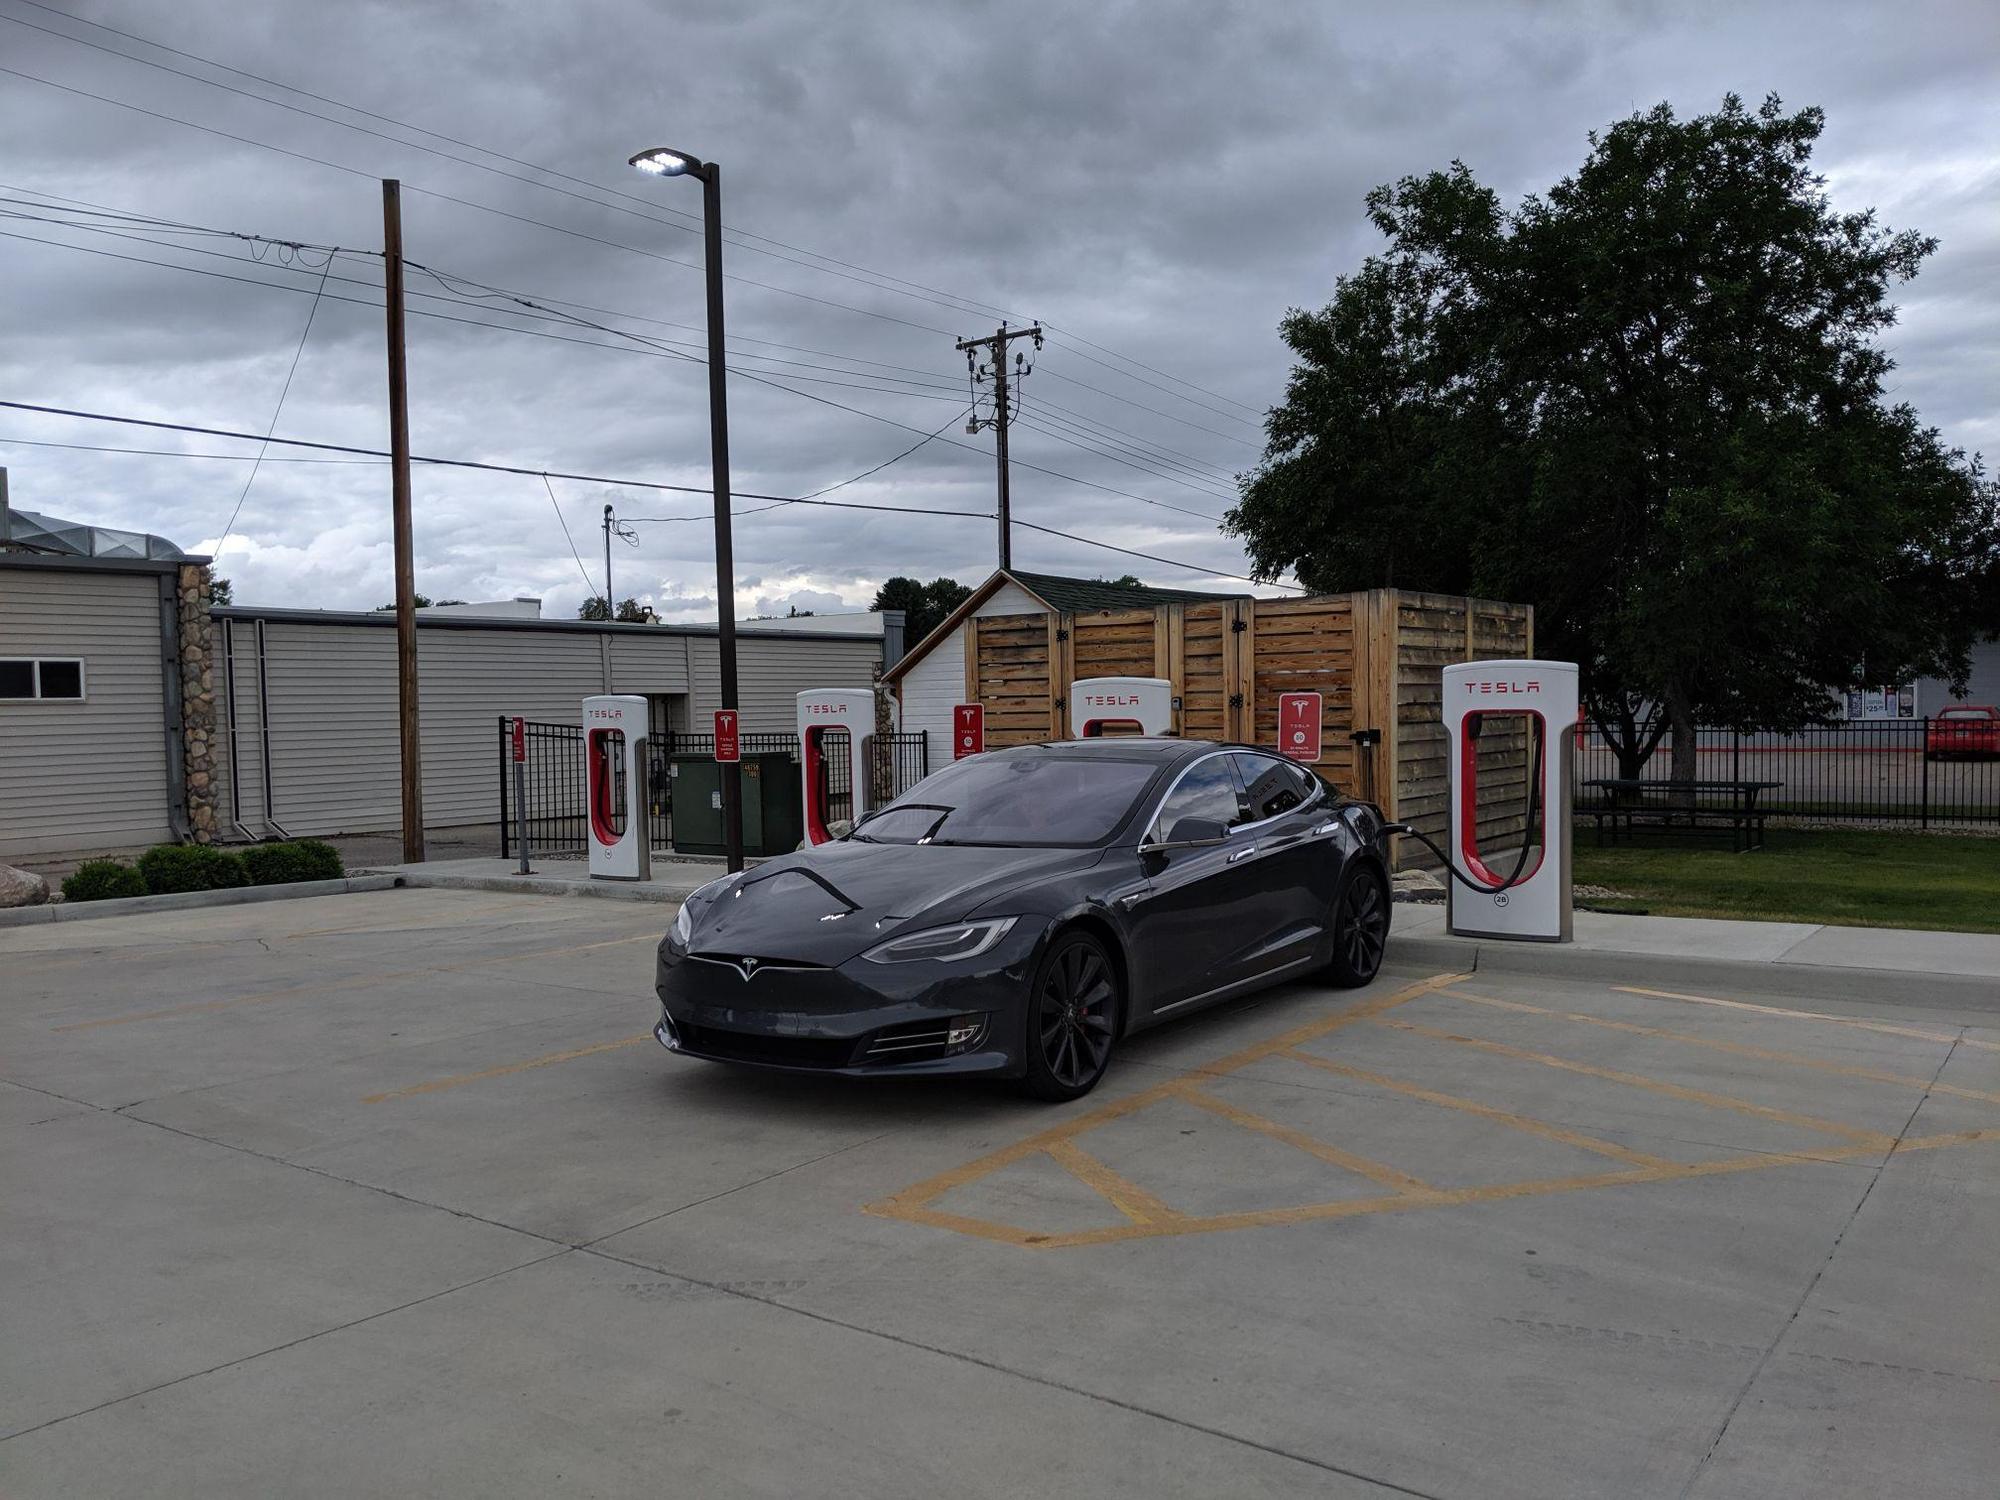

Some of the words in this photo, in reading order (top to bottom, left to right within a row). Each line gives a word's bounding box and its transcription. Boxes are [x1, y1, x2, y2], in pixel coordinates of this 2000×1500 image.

[1464, 681, 1539, 694] TESLA
[1085, 695, 1139, 706] TESLA
[805, 704, 847, 714] TESLA
[588, 710, 622, 719] TESLA
[1496, 895, 1507, 903] 2B
